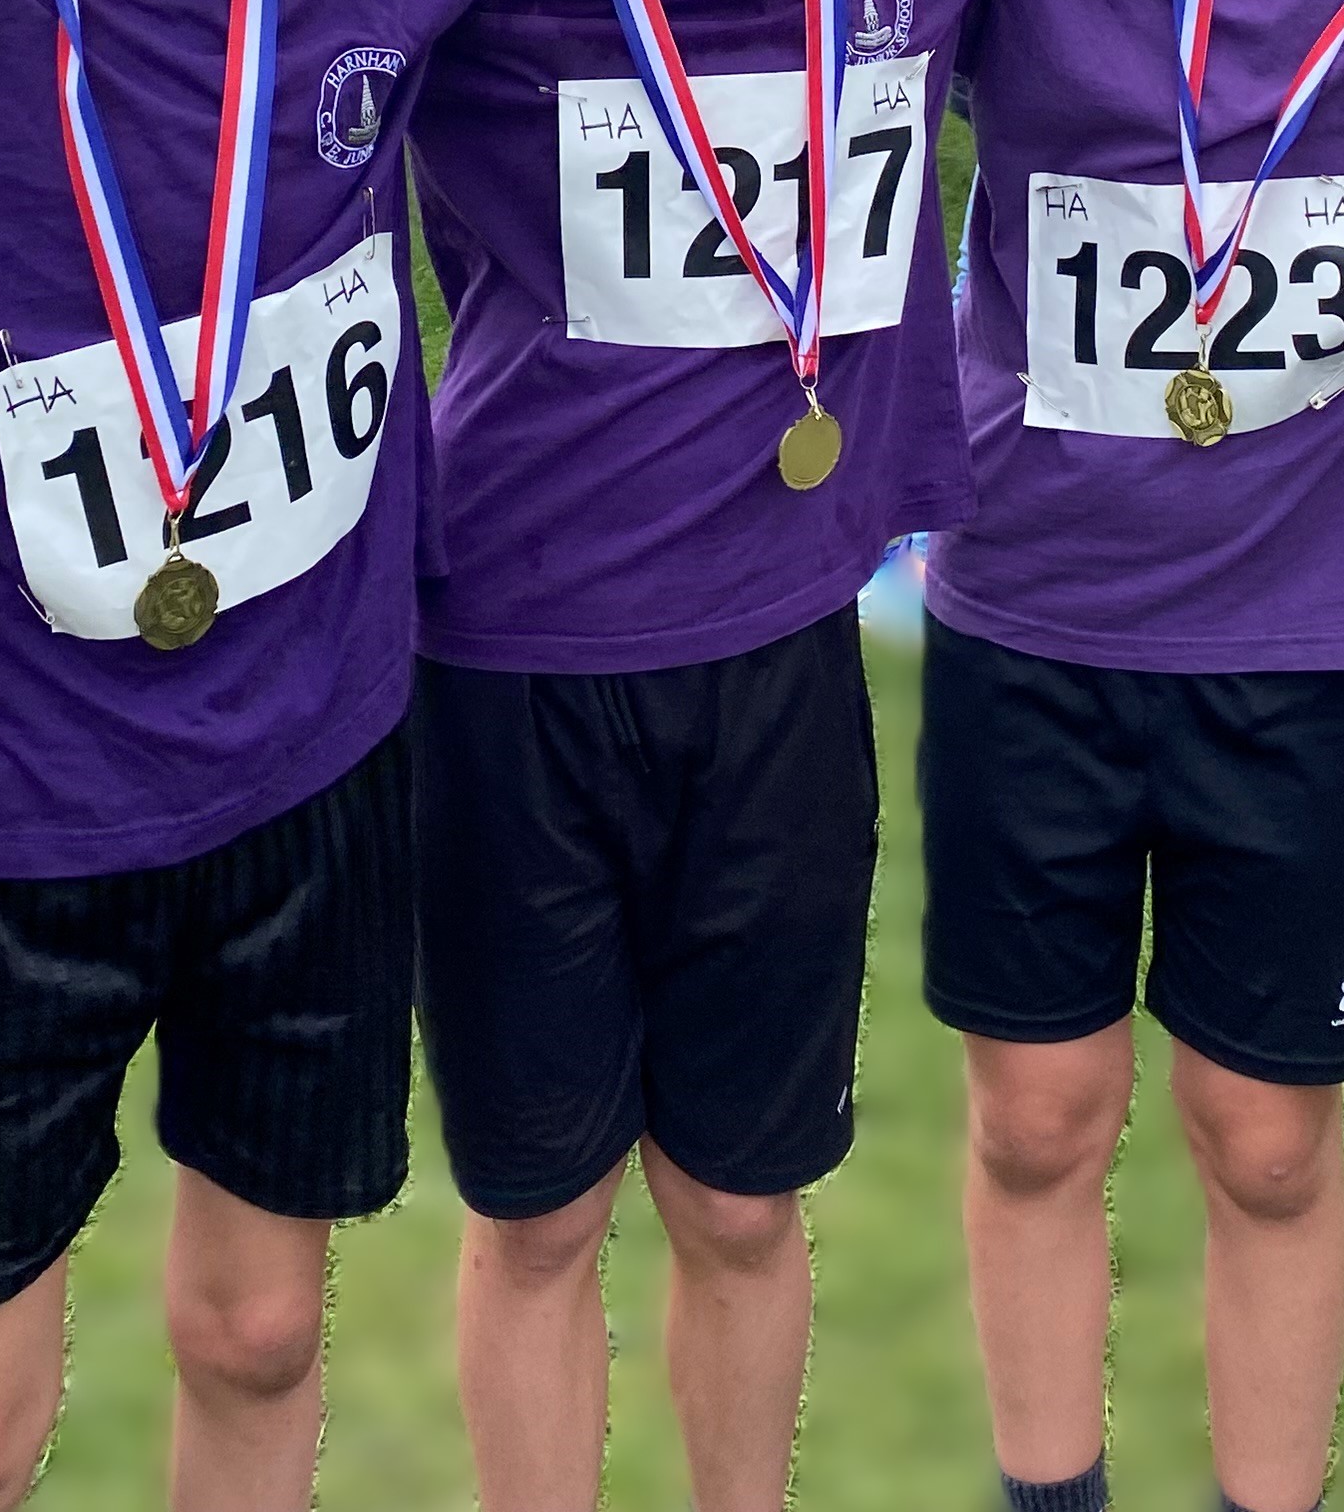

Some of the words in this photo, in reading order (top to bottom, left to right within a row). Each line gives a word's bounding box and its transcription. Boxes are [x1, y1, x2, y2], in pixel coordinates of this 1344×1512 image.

[327, 51, 400, 89] HARNHAM
[873, 82, 911, 115] HA
[578, 102, 643, 141] HA
[596, 125, 913, 279] 1217
[1044, 188, 1089, 222] HA
[324, 268, 369, 314] HA
[3, 375, 77, 419] HA
[41, 320, 388, 569] 1216
